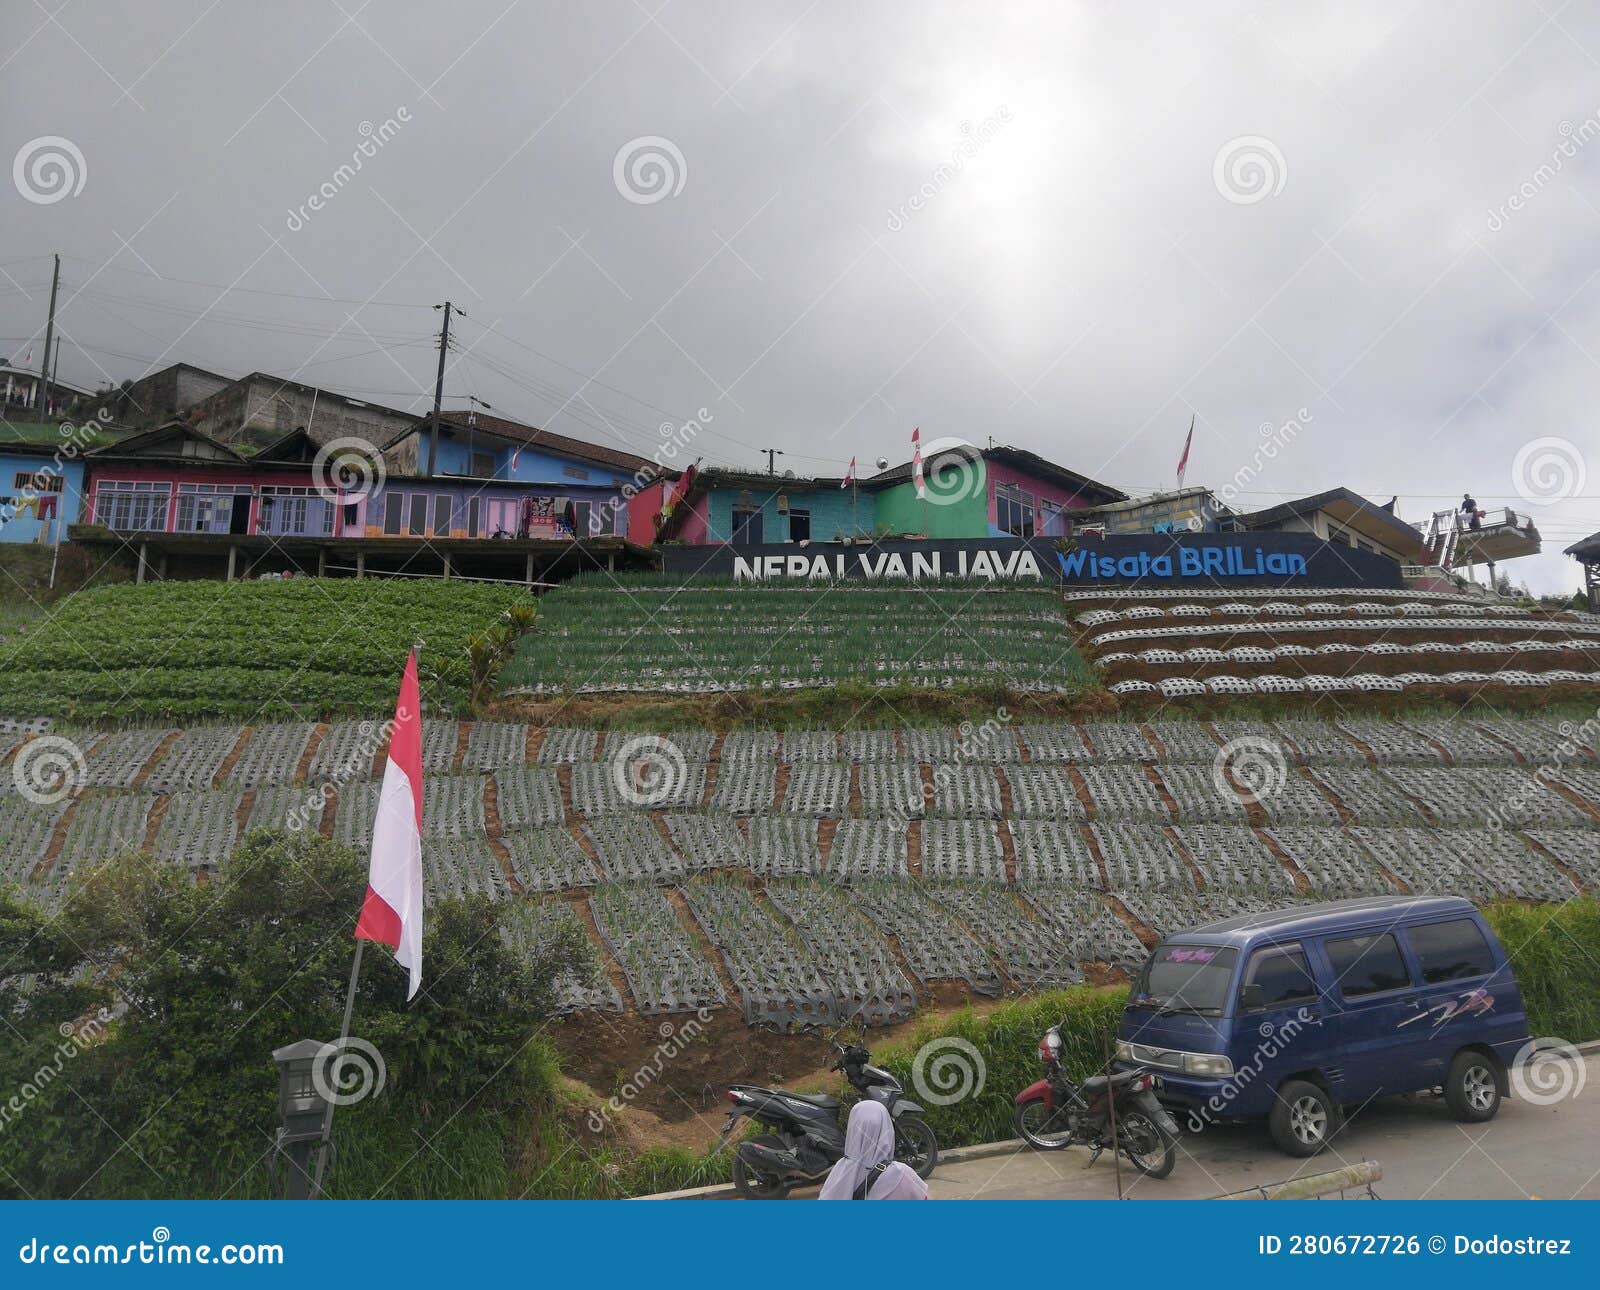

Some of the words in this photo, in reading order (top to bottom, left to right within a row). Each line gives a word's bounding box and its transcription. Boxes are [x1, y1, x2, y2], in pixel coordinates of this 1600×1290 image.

[858, 551, 941, 581] VAN
[946, 550, 1043, 582] JAVA
[1056, 550, 1173, 578] Wisata
[1179, 546, 1307, 577] BRILian
